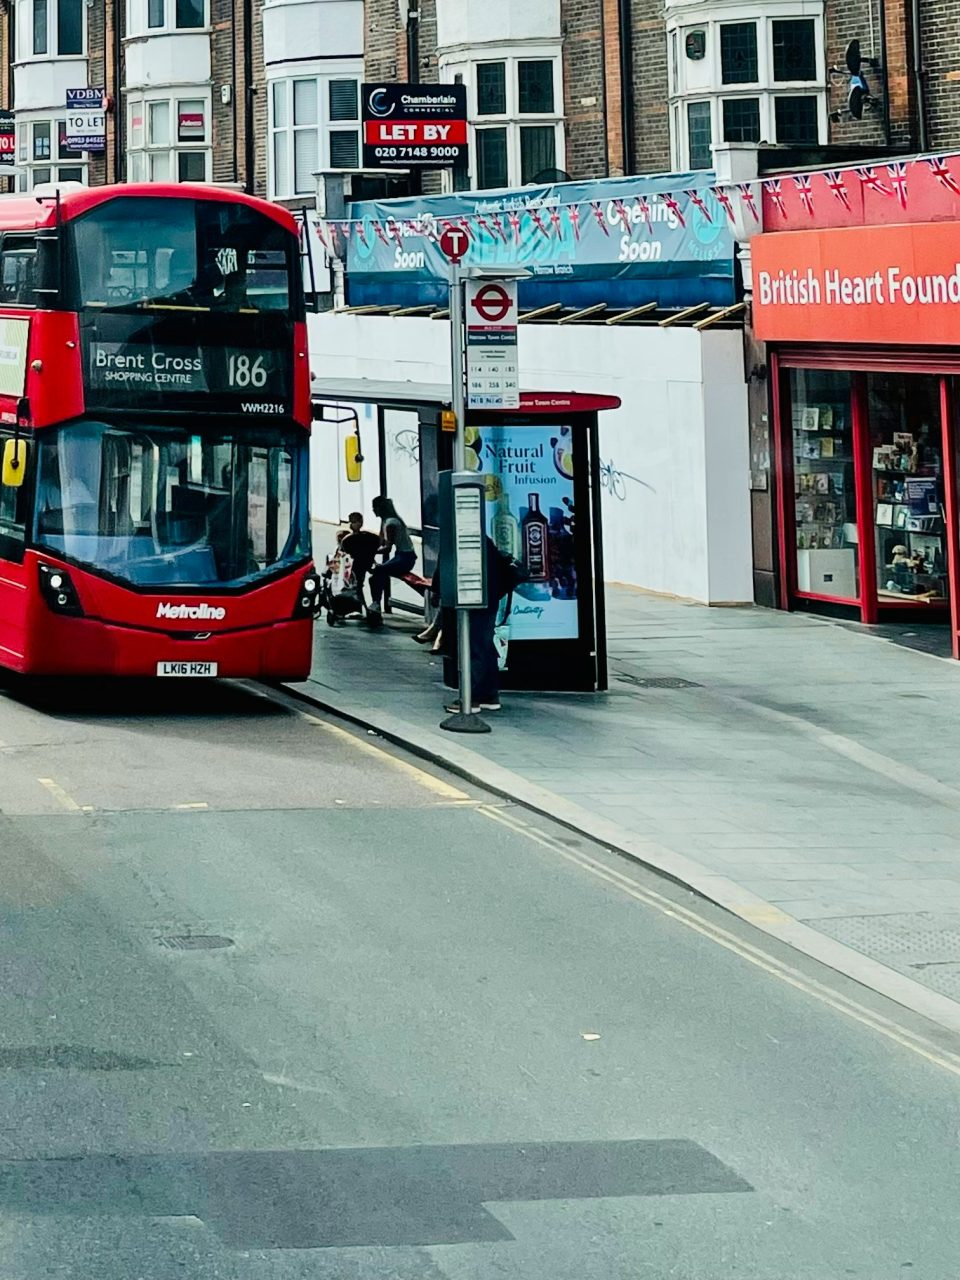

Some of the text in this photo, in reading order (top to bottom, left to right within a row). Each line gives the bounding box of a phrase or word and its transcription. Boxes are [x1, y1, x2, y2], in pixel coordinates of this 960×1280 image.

[67, 90, 105, 99] VDBM
[401, 95, 456, 104] Chamberlain
[68, 116, 104, 127] TO LET
[380, 125, 451, 140] LET BY
[375, 147, 459, 157] 020 7148 9000
[606, 195, 680, 230] Opening
[447, 232, 464, 254] T
[619, 235, 662, 261] Soon
[394, 246, 425, 269] Soon
[759, 263, 960, 305] British Heart Found
[96, 350, 202, 371] Brent Cross
[105, 371, 193, 384] SHOPPING CENTRE
[228, 355, 268, 387] 186
[241, 402, 286, 414] VWH2216
[485, 443, 544, 459] Natural
[499, 459, 537, 474] Fruit
[514, 476, 558, 485] Infusion
[155, 602, 226, 620] Metroline
[163, 663, 211, 675] LK16 HZH
